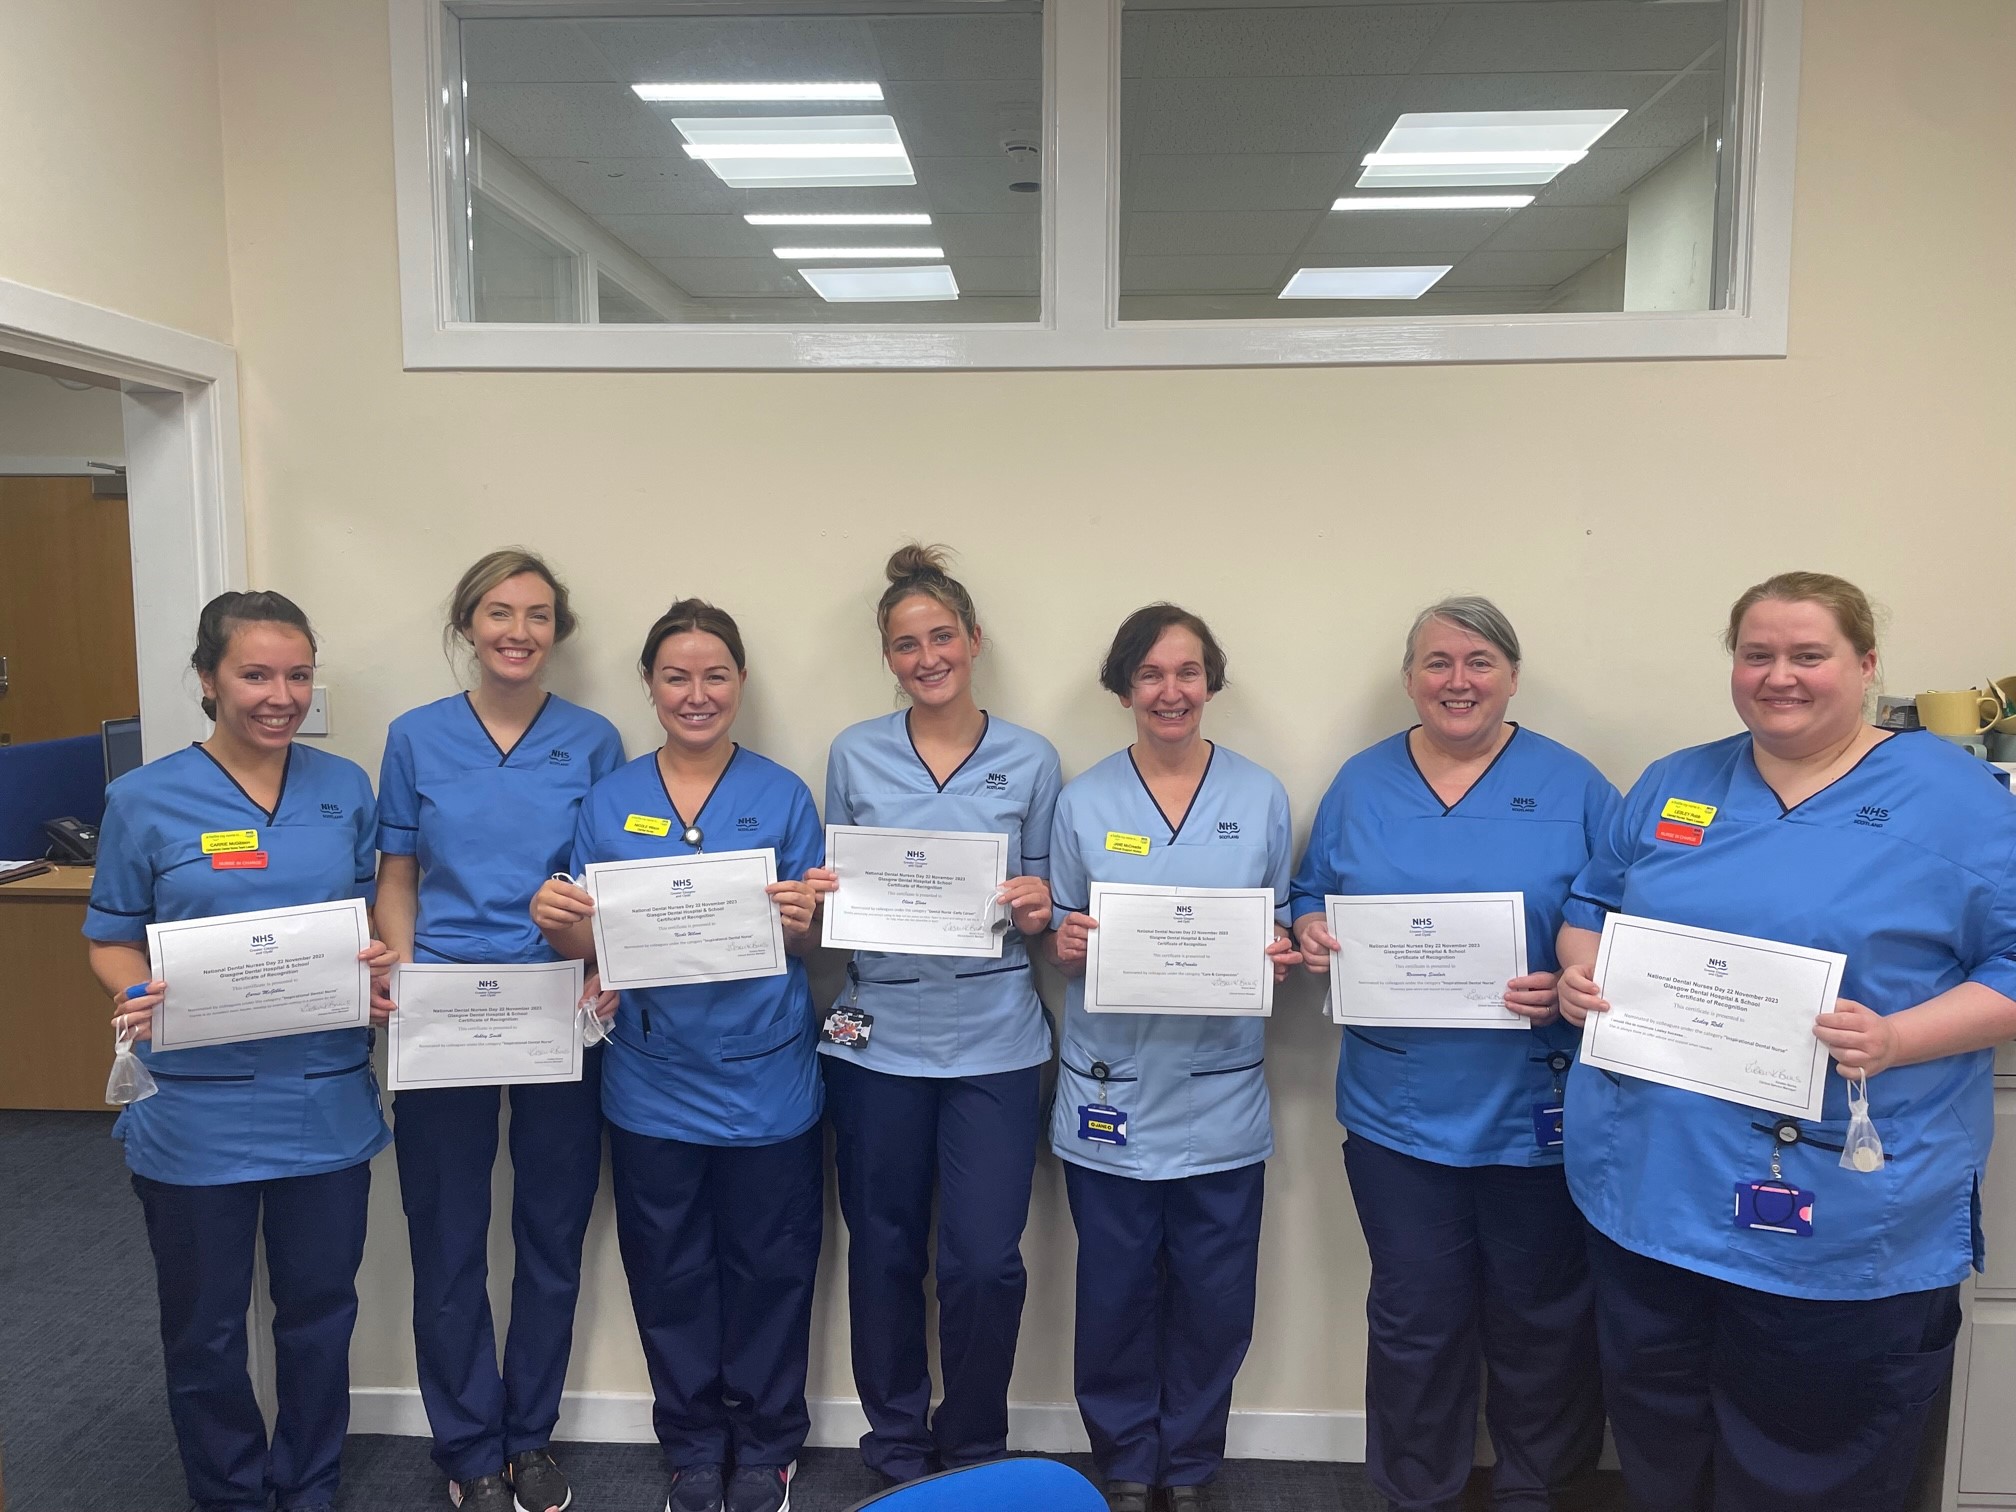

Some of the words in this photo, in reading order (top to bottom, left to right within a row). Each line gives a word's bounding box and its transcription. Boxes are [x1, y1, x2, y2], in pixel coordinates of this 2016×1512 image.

[551, 750, 570, 758] NHS
[988, 773, 1006, 782] NHS
[1860, 806, 1888, 817] NHS
[1219, 822, 1238, 830] NHS
[673, 878, 692, 887] NHS
[252, 934, 274, 943] NHS
[1709, 958, 1727, 968] NHS
[1647, 972, 1672, 982] National
[1672, 977, 1692, 986] Dental
[1692, 981, 1713, 990] Nurses
[1714, 986, 1726, 994] Day
[1734, 990, 1764, 1001] November
[1663, 982, 1690, 992] Glasgow
[1690, 988, 1709, 997] Dental
[1710, 992, 1734, 1002] Hospital
[1740, 998, 1761, 1007] School
[1675, 992, 1706, 1003] Certificate
[1713, 1000, 1748, 1012] Recognition
